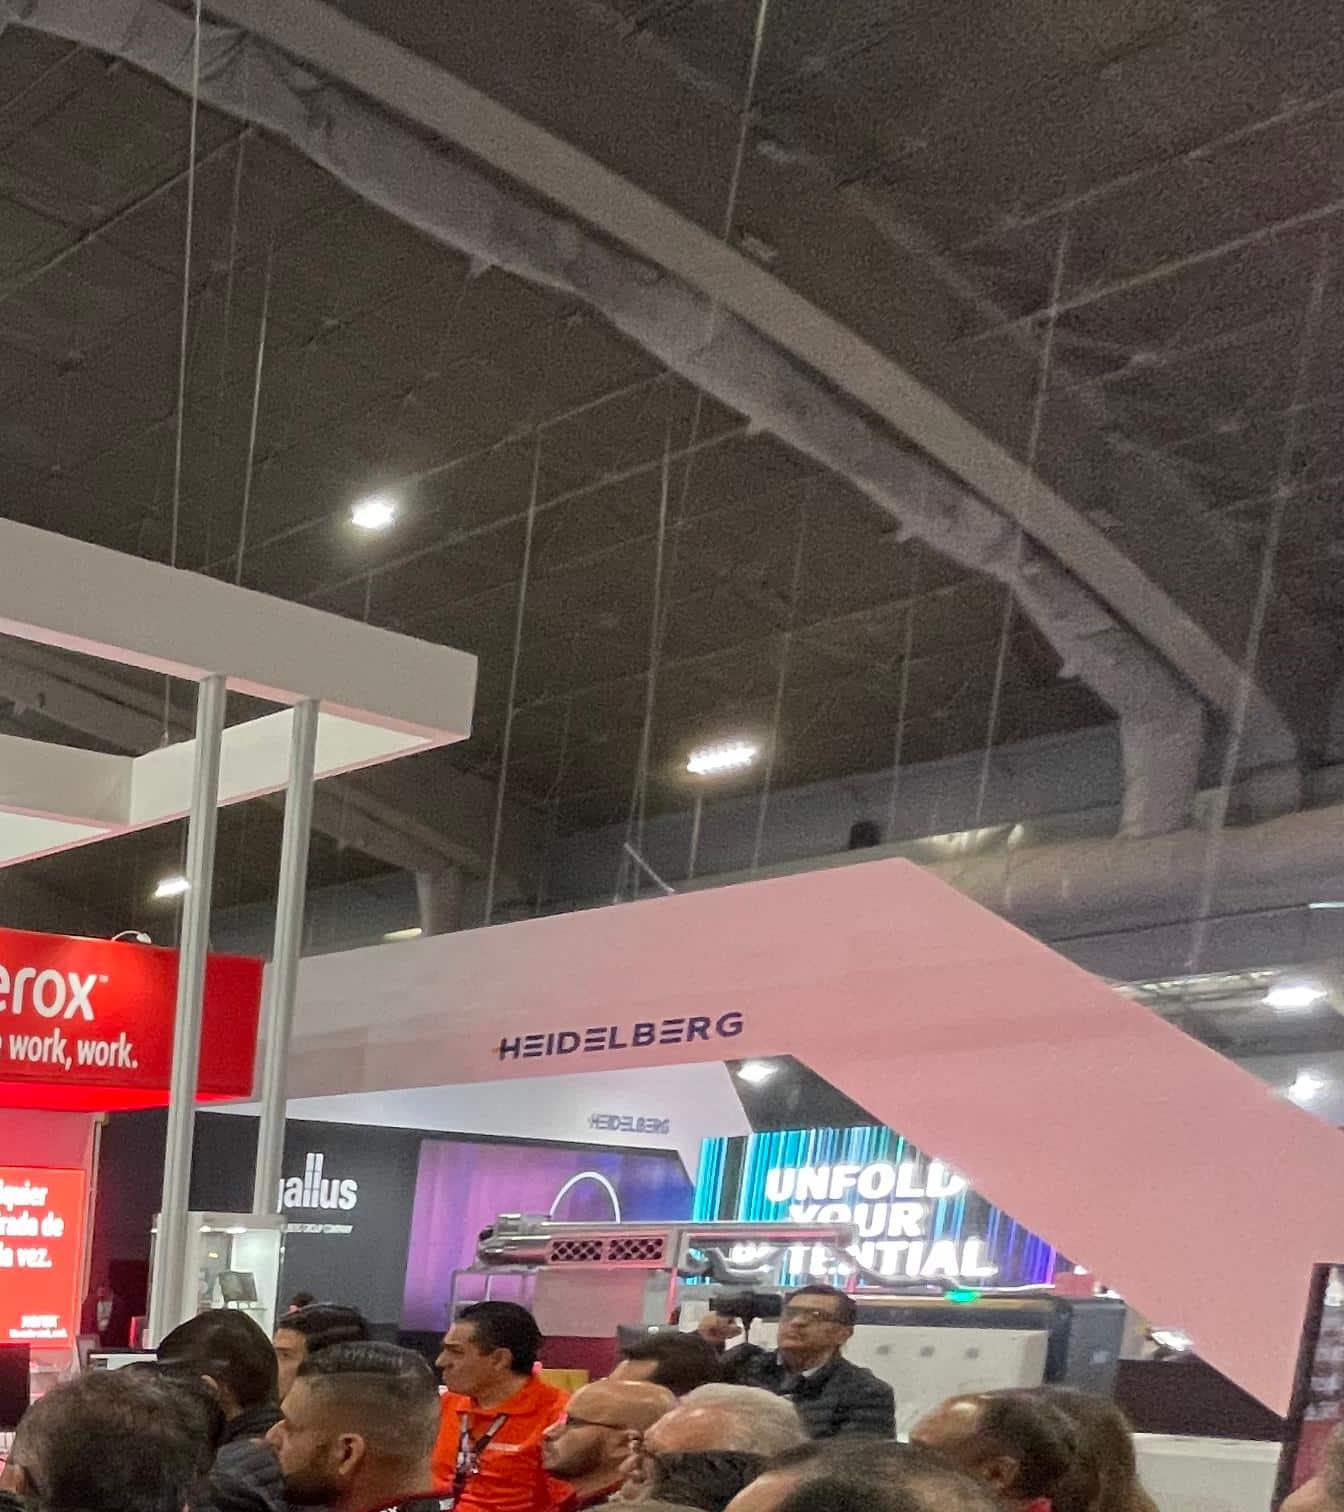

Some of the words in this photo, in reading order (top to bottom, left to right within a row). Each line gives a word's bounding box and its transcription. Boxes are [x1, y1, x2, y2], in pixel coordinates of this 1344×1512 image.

[9, 1027, 72, 1071] work,
[77, 1032, 138, 1068] work.
[499, 1012, 743, 1060] HEIDELBERG
[588, 1112, 670, 1134] HEIDELBERG
[766, 1159, 967, 1202] UNFOLD
